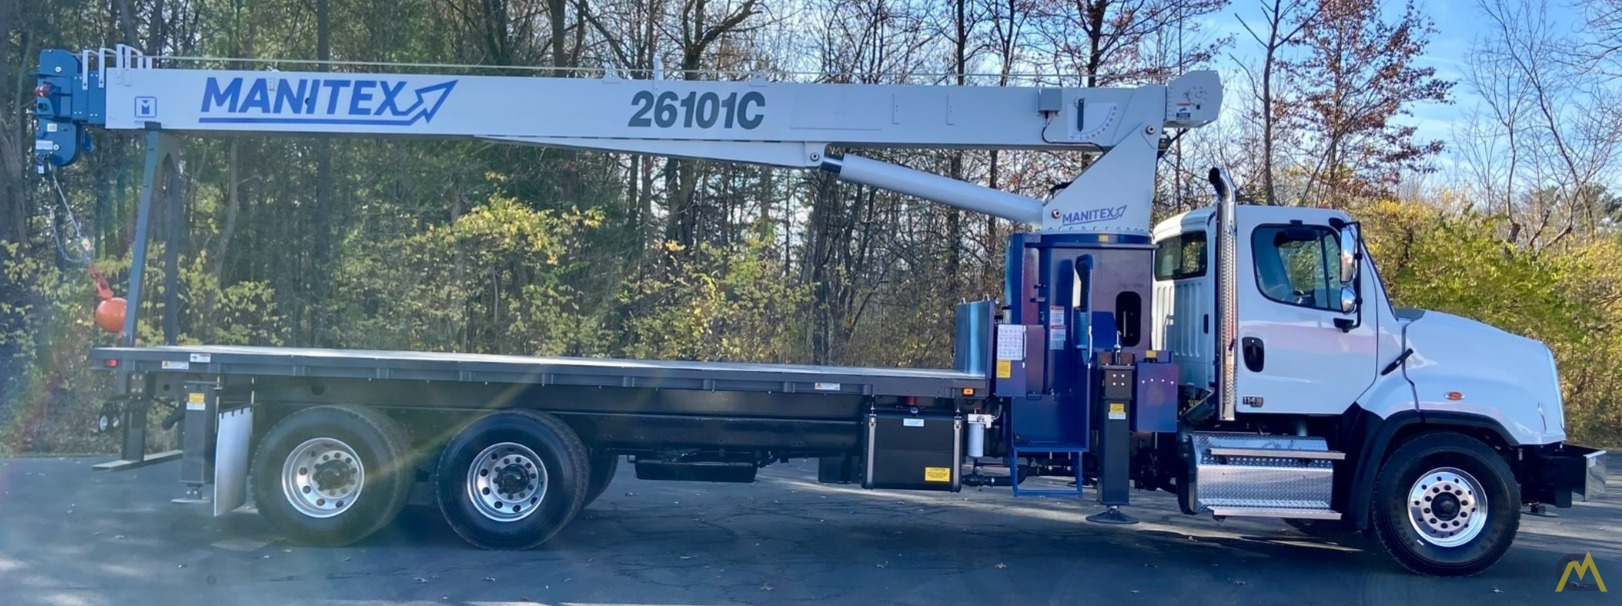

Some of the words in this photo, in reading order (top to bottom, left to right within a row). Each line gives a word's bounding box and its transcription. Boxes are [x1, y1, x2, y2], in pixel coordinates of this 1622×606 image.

[200, 77, 408, 116] MANITEX
[628, 90, 766, 130] 26101C
[1062, 207, 1114, 224] MANITEX
